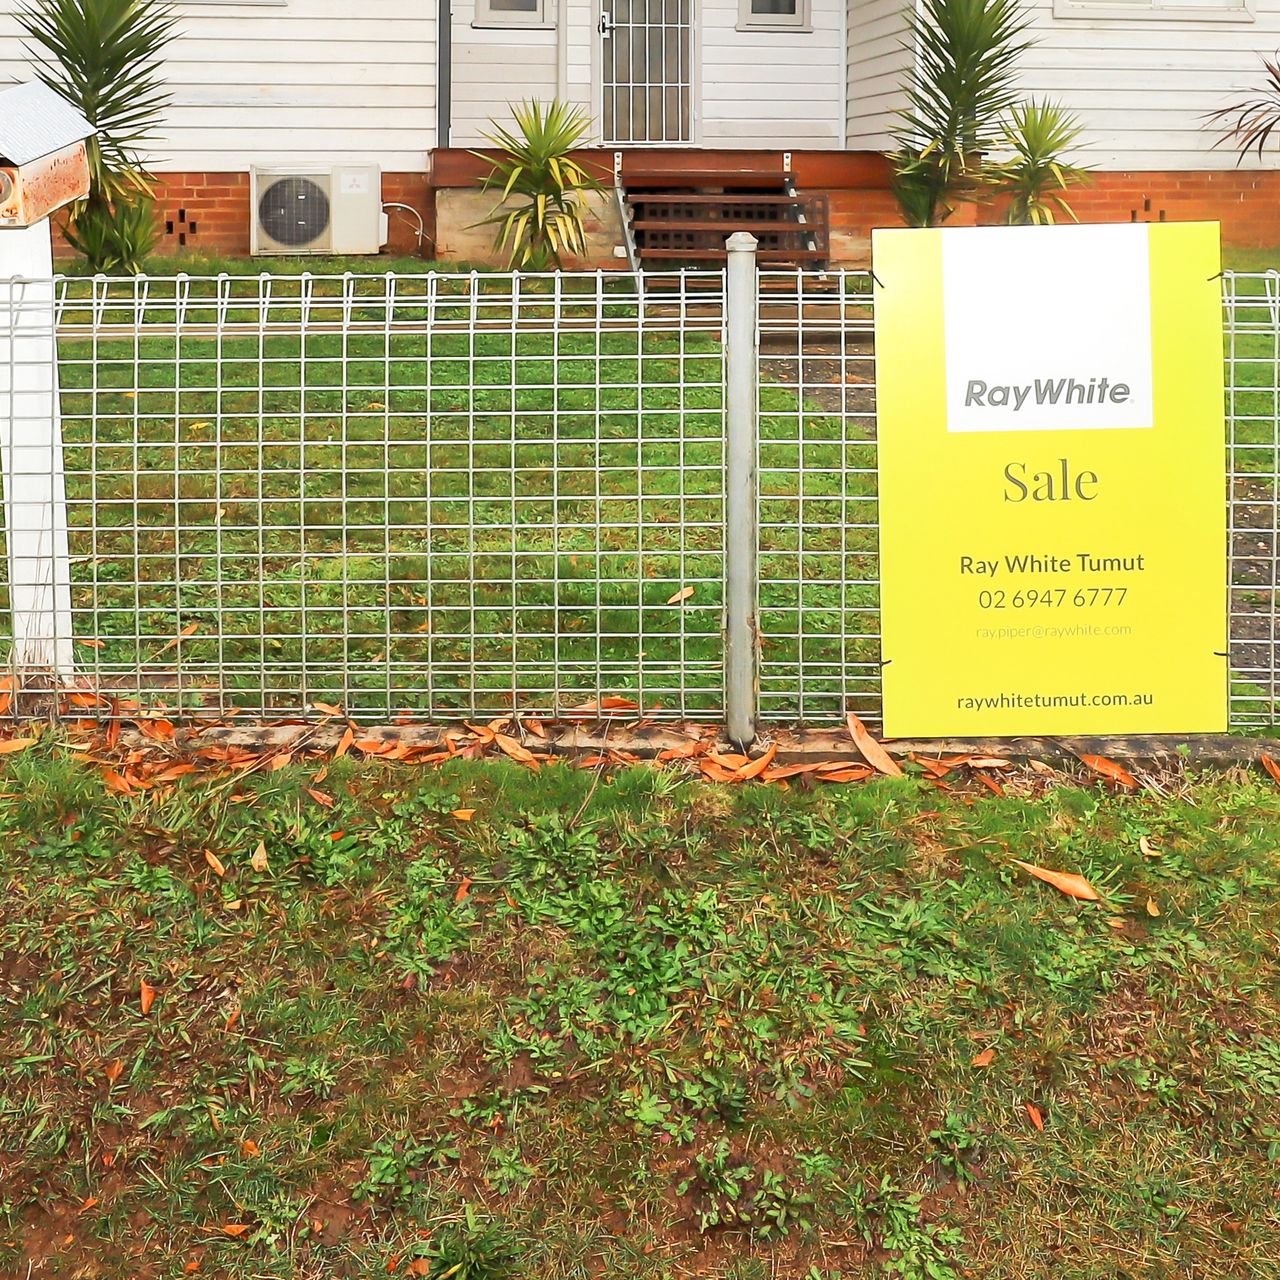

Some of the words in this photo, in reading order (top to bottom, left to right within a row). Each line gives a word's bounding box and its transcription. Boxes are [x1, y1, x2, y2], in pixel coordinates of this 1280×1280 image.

[1004, 458, 1098, 503] Sale
[960, 556, 999, 578] Ray
[1004, 554, 1071, 573] White
[1076, 553, 1145, 572] Tumut
[979, 589, 1006, 609] 02
[1012, 588, 1067, 609] 6947
[1073, 587, 1128, 608] 6777
[976, 624, 1132, 640] ray.piper@raywhite.com
[957, 692, 1154, 712] raywhitetumut.com.au
